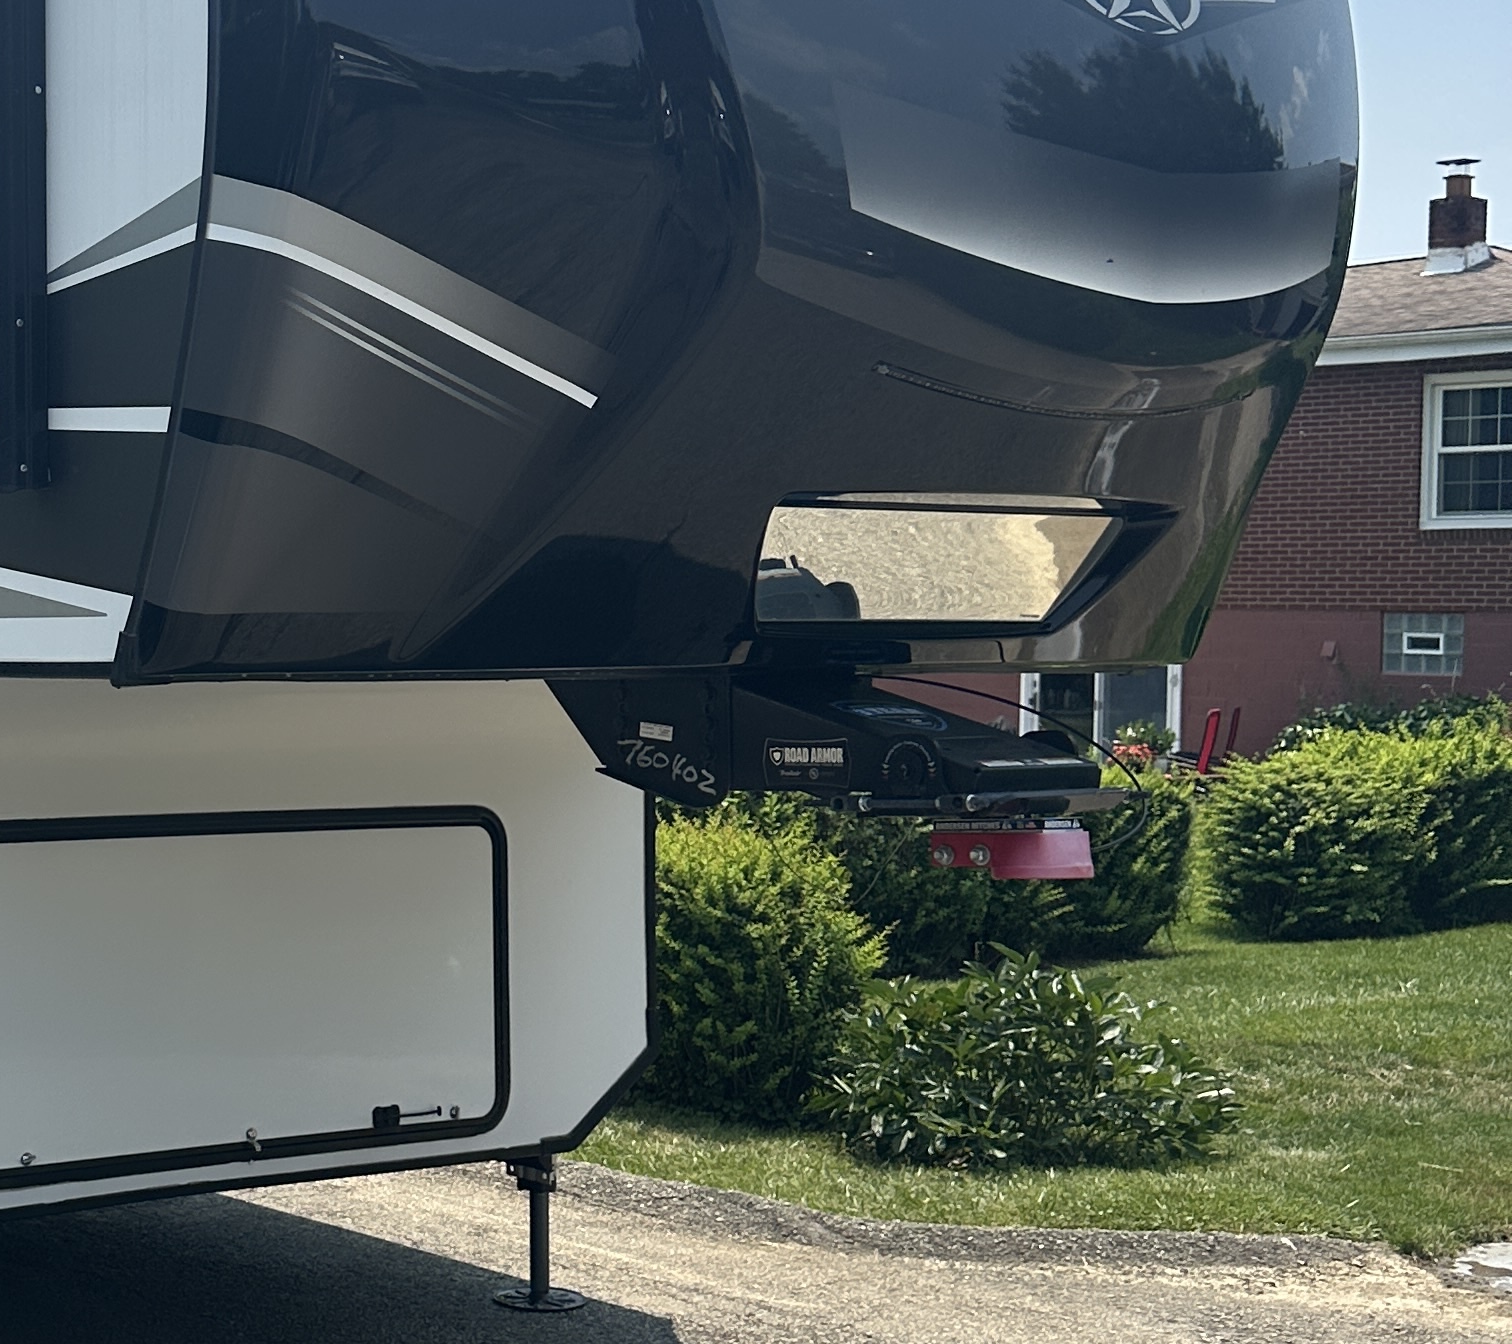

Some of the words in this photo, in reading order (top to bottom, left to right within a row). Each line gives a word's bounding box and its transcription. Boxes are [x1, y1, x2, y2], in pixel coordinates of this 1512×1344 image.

[617, 739, 716, 795] 760402
[784, 747, 809, 763] ROAD
[811, 747, 843, 763] ARMOR
